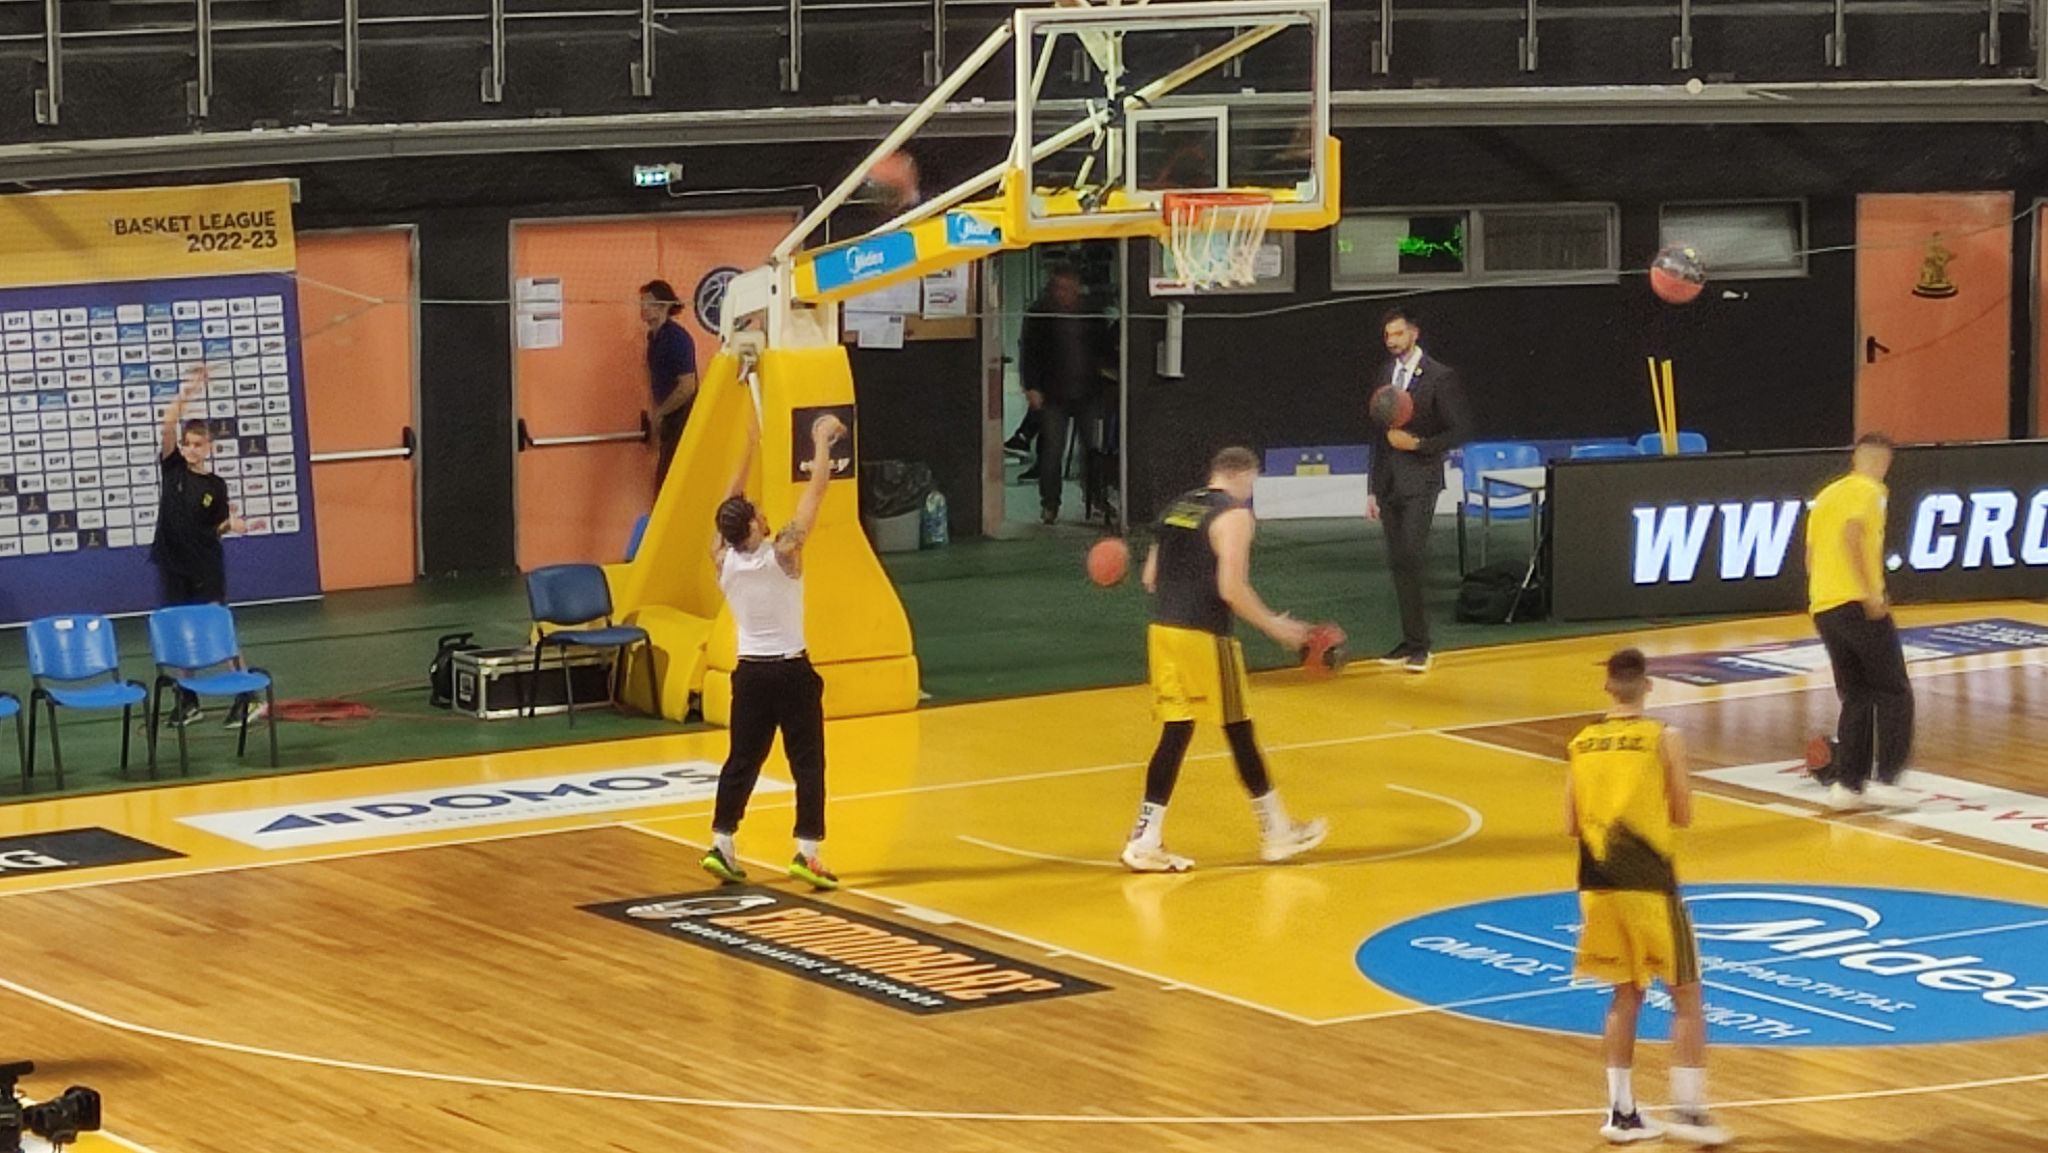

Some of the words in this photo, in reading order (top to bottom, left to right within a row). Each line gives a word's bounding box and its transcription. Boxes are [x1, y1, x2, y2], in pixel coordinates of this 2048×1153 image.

[114, 215, 192, 235] BASKET
[199, 210, 277, 230] LEAGUE
[187, 230, 278, 253] 2022-23
[355, 768, 721, 821] DOMOS
